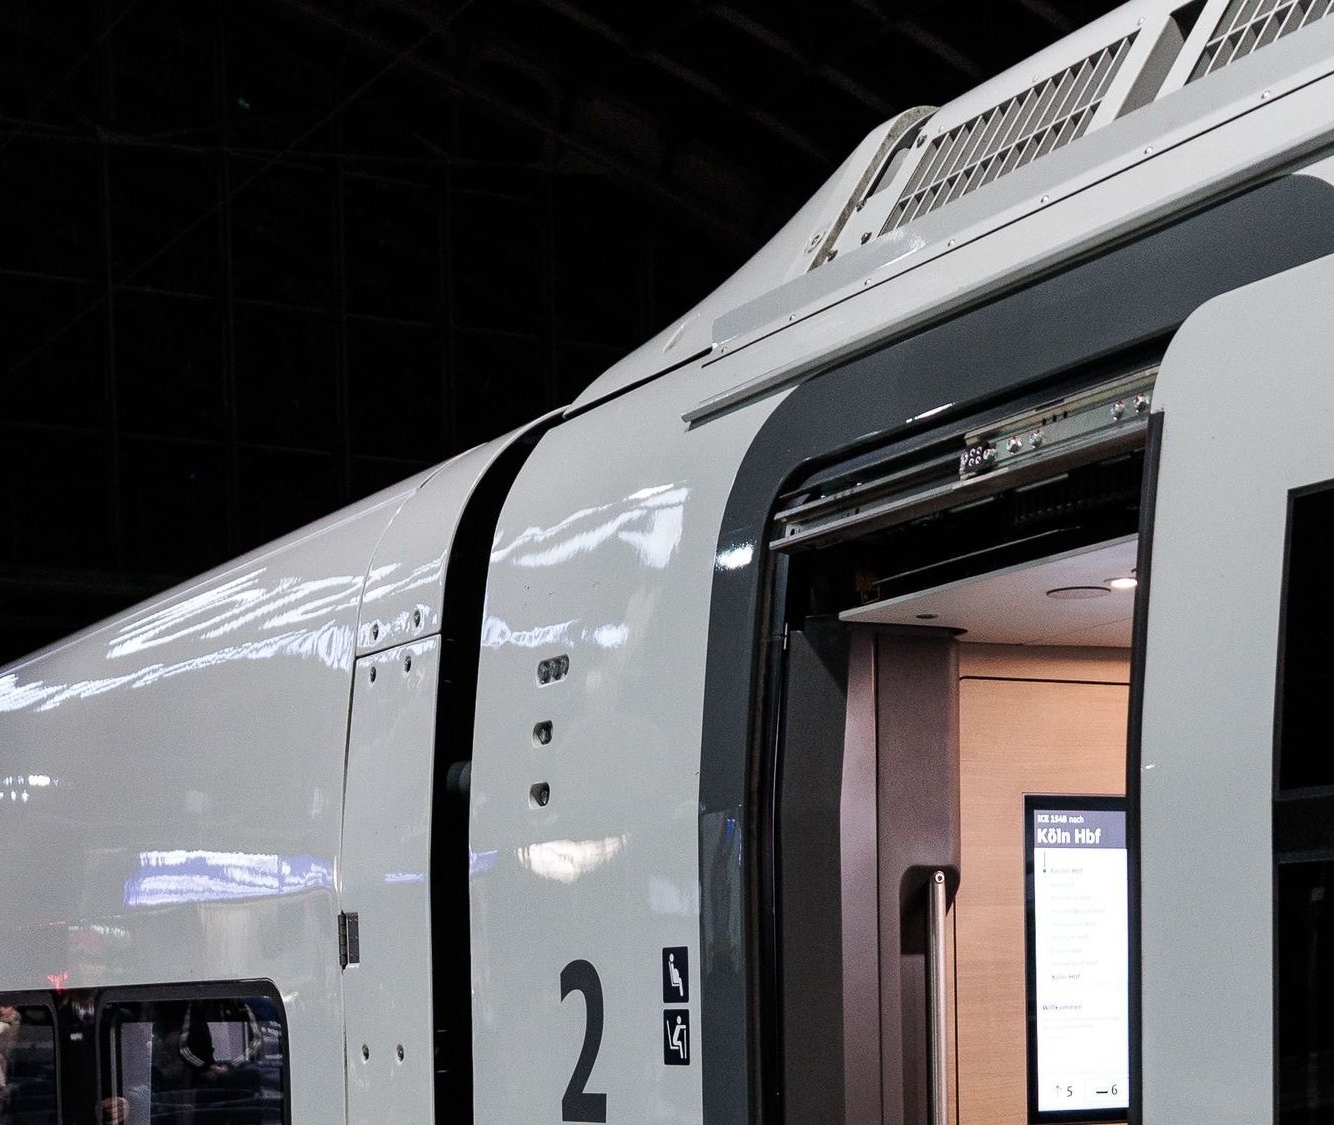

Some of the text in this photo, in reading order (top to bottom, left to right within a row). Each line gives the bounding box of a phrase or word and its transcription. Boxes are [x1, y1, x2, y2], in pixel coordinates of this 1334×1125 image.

[1037, 815, 1084, 823] ICE 1548 nach
[1037, 828, 1101, 844] Köln Hbf
[560, 959, 607, 1123] 2
[1111, 1084, 1118, 1095] 6
